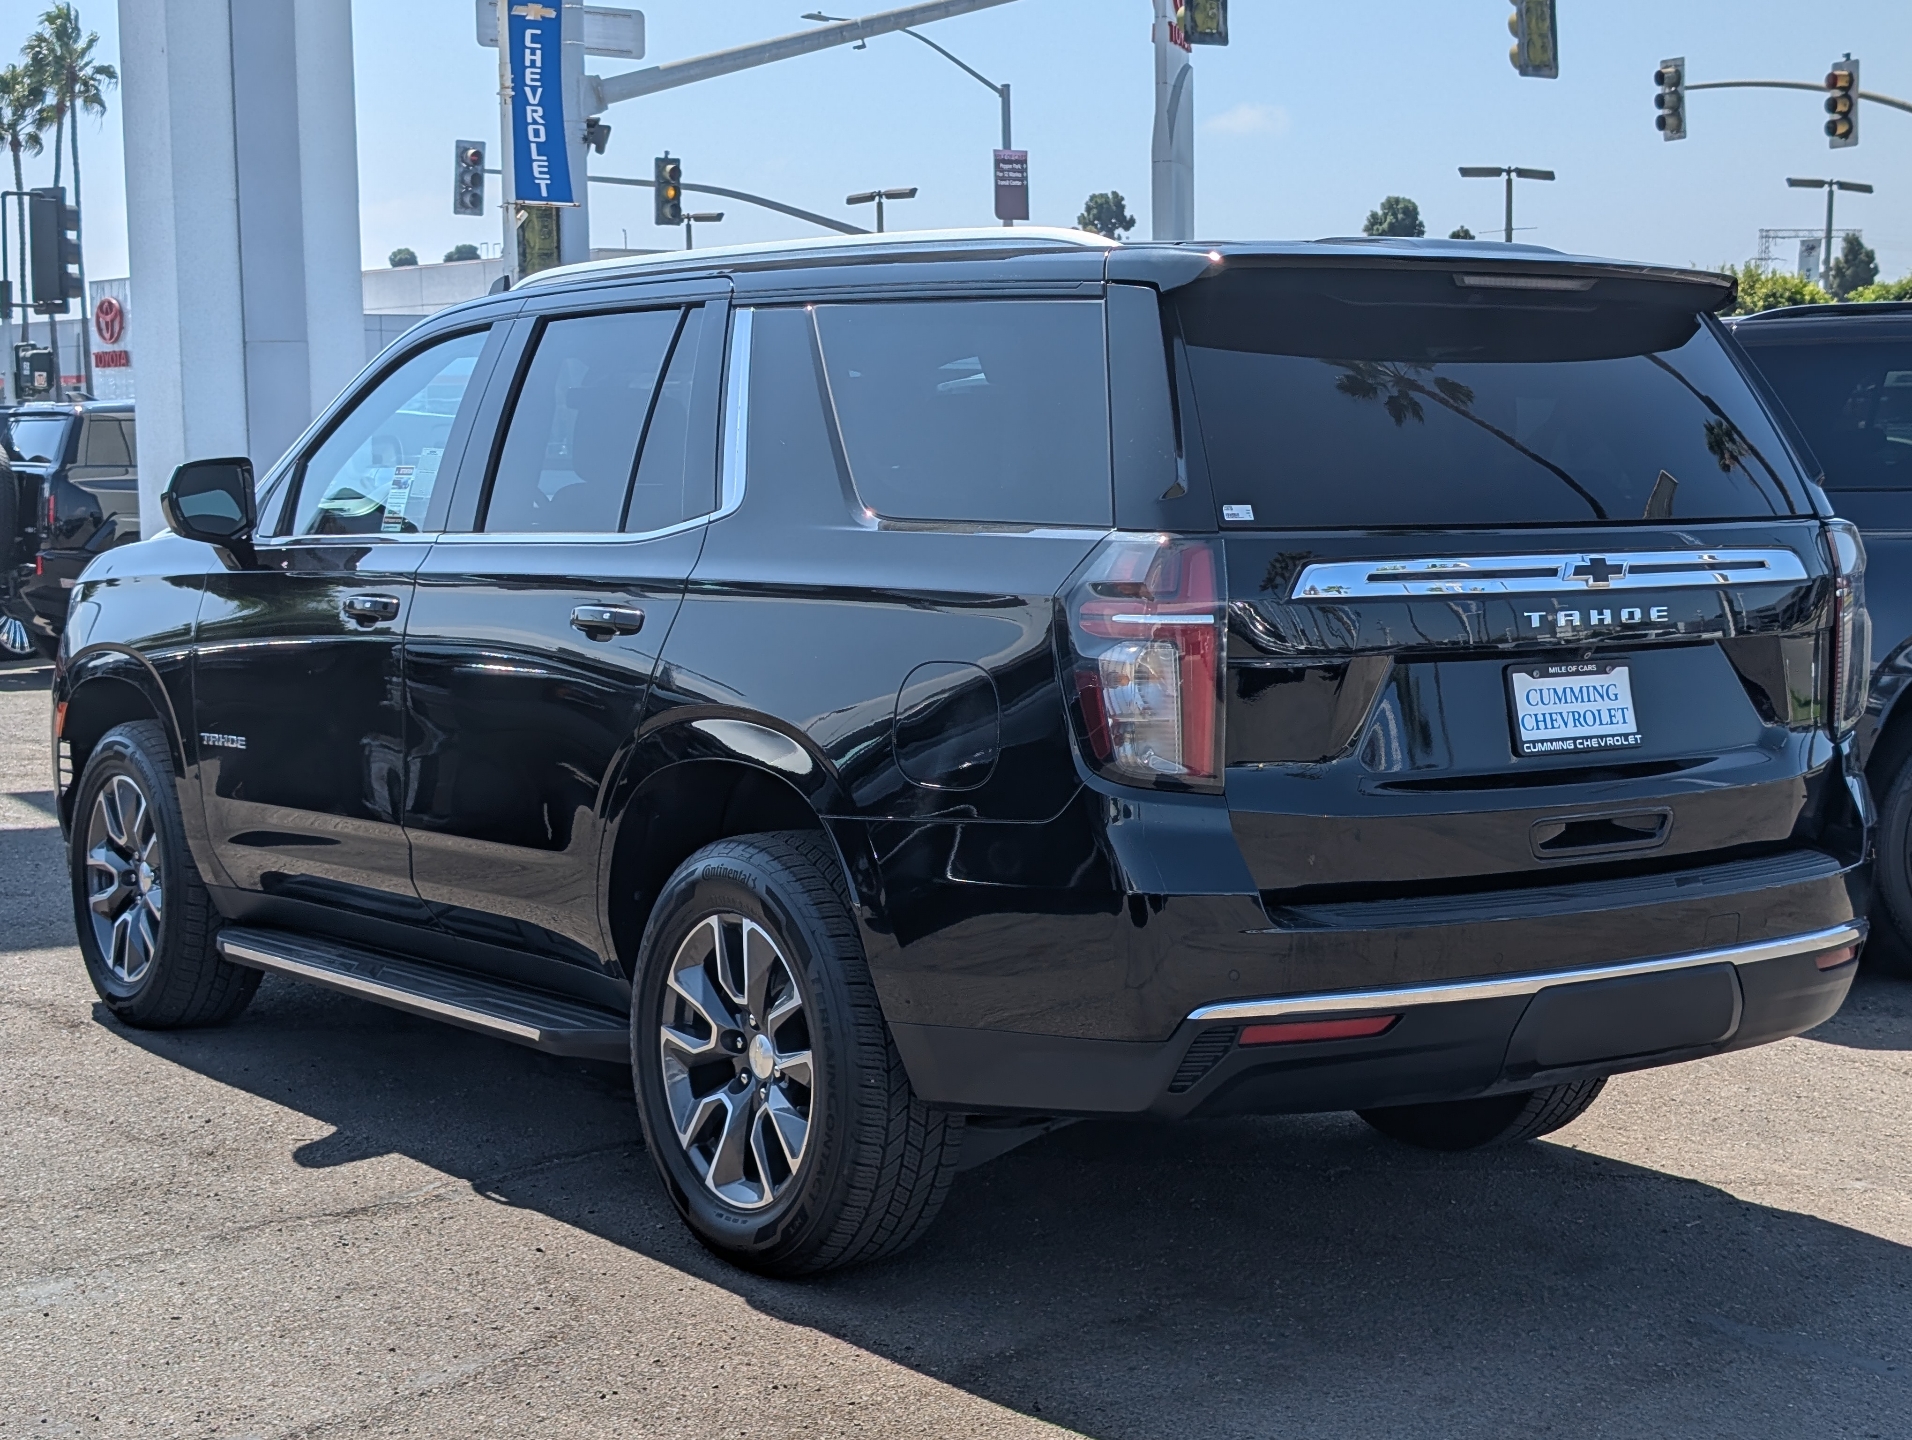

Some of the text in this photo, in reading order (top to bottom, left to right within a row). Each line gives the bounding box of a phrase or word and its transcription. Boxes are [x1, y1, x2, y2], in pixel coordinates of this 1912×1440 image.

[524, 29, 551, 197] CHEVROLET
[92, 351, 128, 367] TOYOTA
[1523, 607, 1669, 628] TAHOE
[1549, 664, 1597, 674] MILE OF CARS
[1525, 683, 1618, 706] CUMMING
[1520, 707, 1629, 731] CHEVROLET
[200, 732, 247, 749] TAHOE
[1523, 735, 1642, 752] CUMMING CHEVROLET
[702, 863, 752, 885] Continental
